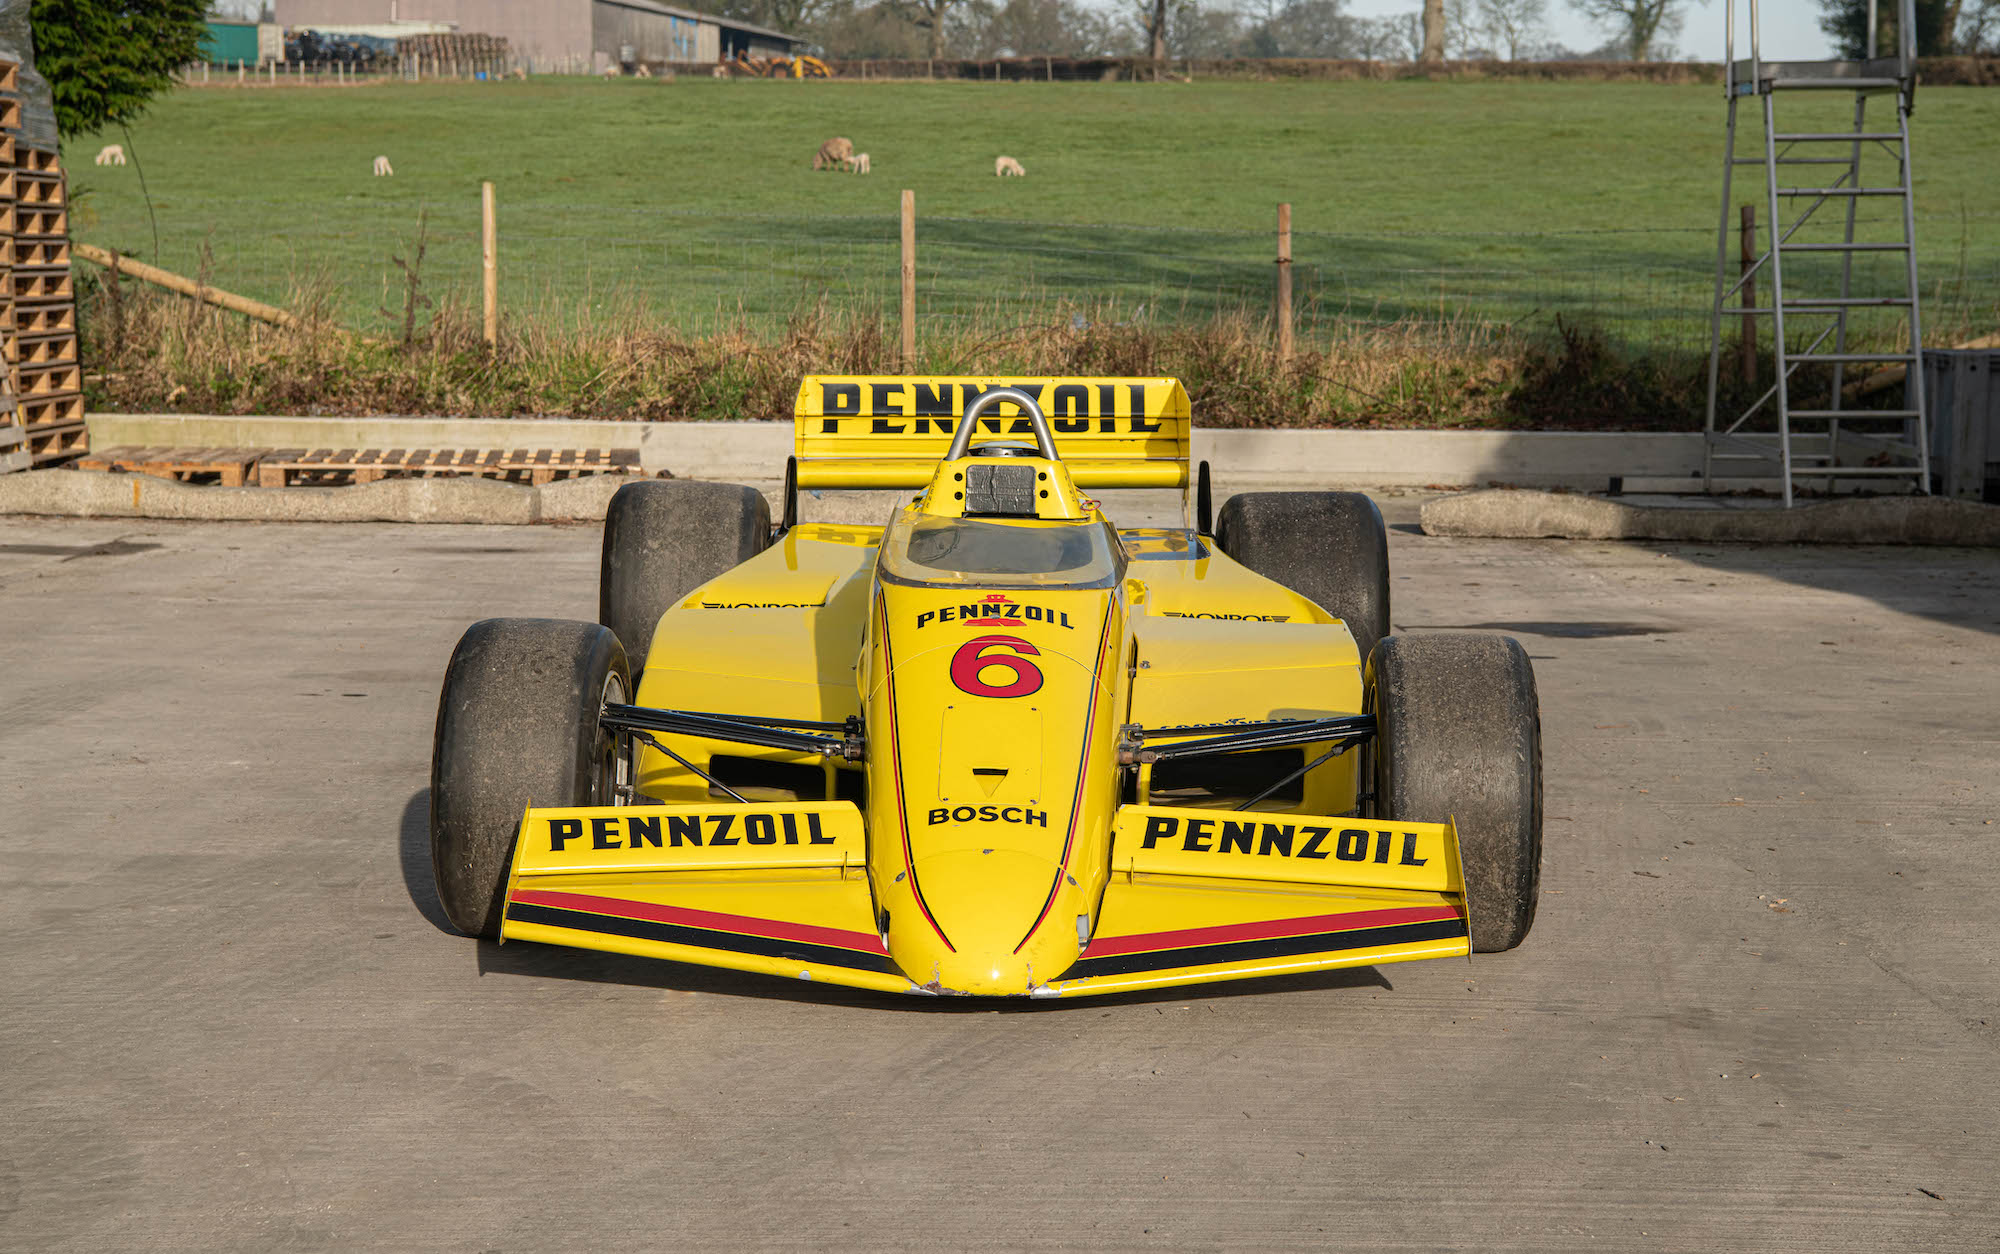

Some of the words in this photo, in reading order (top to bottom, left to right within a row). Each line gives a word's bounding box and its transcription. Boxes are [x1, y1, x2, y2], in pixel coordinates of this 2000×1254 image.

[819, 383, 1162, 434] PENNZOIL
[917, 604, 1075, 629] PENNZOIL
[949, 635, 1044, 698] 6
[547, 813, 837, 851] PENNZOIL
[928, 806, 1047, 828] BOSCH
[1141, 816, 1428, 867] PENNZOIL
